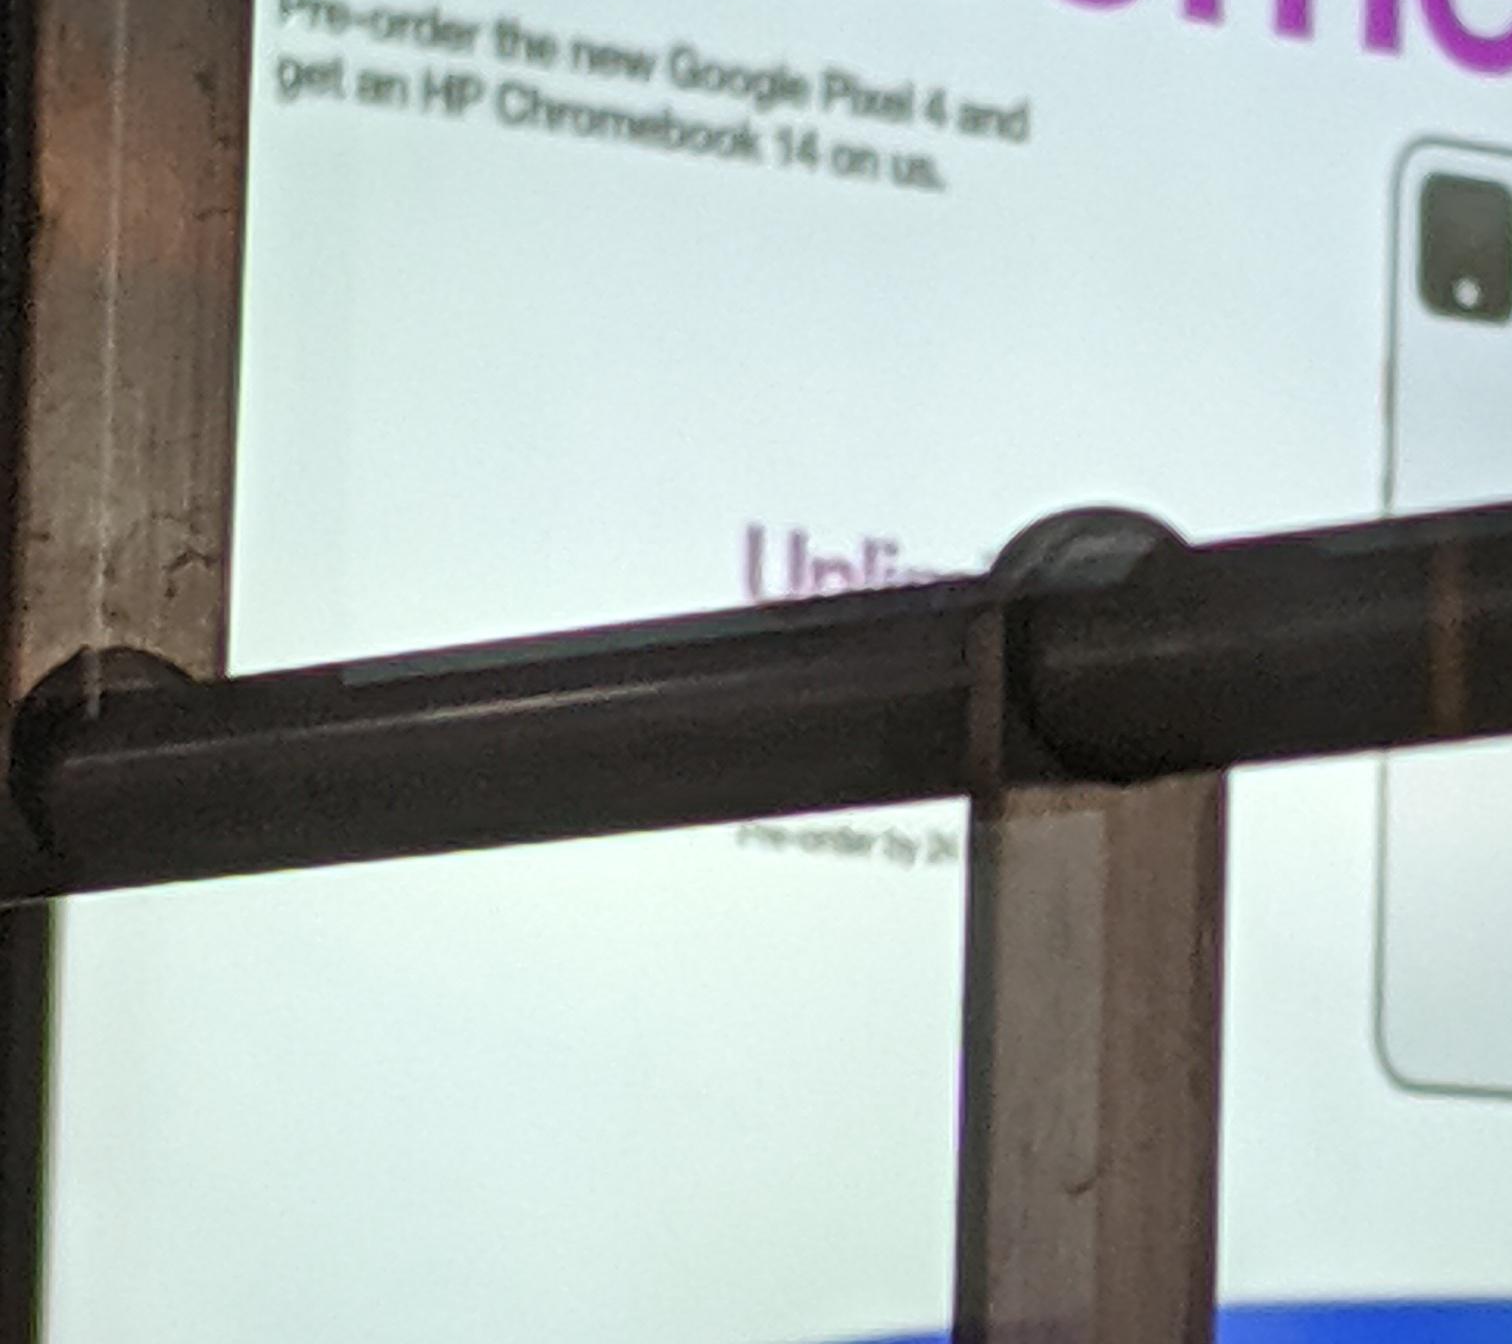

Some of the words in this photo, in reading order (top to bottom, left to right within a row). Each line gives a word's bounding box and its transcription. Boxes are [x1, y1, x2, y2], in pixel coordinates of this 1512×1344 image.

[277, 52, 347, 106] get
[354, 66, 408, 106] an
[420, 64, 487, 116] HP
[495, 78, 759, 158] Chromebook
[774, 124, 821, 172] 14
[829, 142, 880, 182] on
[493, 13, 560, 69] the
[570, 39, 655, 83] new
[669, 42, 810, 114] Google
[820, 65, 914, 124] Pixel
[923, 86, 948, 131] 4
[956, 94, 1031, 146] and
